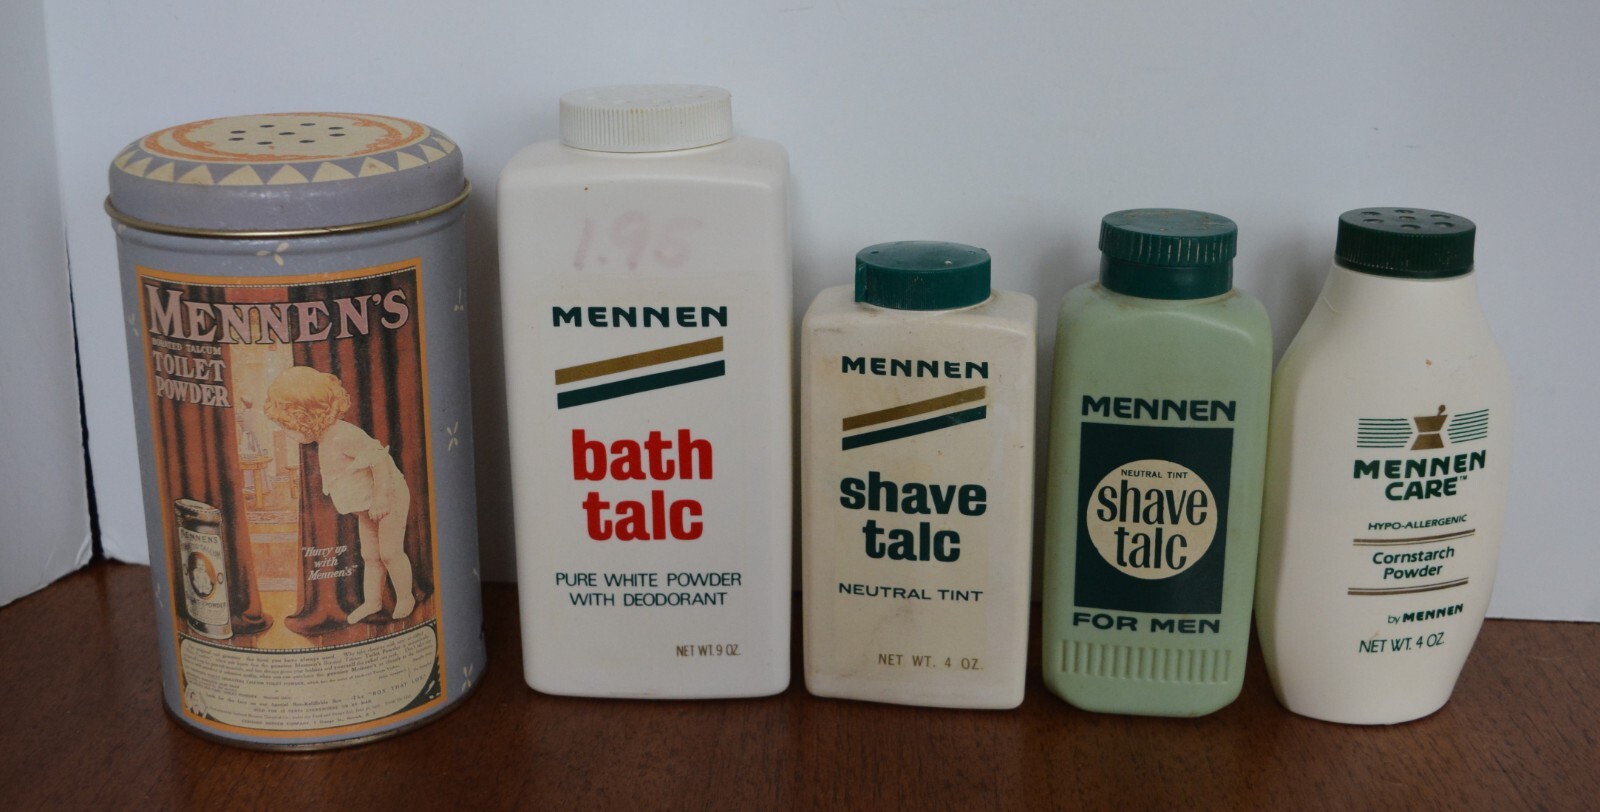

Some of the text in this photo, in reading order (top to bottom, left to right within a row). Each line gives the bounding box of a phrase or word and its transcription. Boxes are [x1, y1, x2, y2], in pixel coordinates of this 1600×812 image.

[573, 210, 703, 272] 1.95
[146, 284, 410, 344] MENNEN'S
[552, 306, 728, 328] MENNEN
[153, 350, 226, 381] TOILET
[842, 355, 989, 379] MENNEN
[155, 375, 230, 406] POWDER
[1081, 395, 1236, 422] MENNEN
[572, 428, 713, 481] bath
[1353, 450, 1486, 479] MENNEN
[1121, 469, 1188, 479] NEUTRAL TINT
[839, 471, 987, 516] shave
[1385, 477, 1458, 501] CARE
[1096, 479, 1208, 526] shave
[582, 490, 704, 541] talc
[1368, 514, 1468, 530] HYPO-ALLERGENIC
[335, 545, 348, 556] up
[862, 519, 961, 562] talc
[1114, 527, 1188, 570] talc
[314, 556, 338, 568] with
[1372, 546, 1455, 564] Cornstarch
[556, 572, 742, 587] PURE WHITE POWDER
[1383, 565, 1443, 580] Powder
[570, 592, 728, 606] WITH DEODORANT
[839, 582, 984, 602] NEUTRAL TINT
[1073, 612, 1220, 634] FOR MEN
[1387, 604, 1464, 625] by MENNEN
[676, 644, 694, 657] NET
[698, 644, 715, 656] WT.
[716, 644, 723, 656] 9
[1358, 639, 1387, 653] NET
[1391, 637, 1412, 652] WT.
[1416, 636, 1423, 649] 4
[878, 653, 984, 670] NET WT. 4 OZ.
